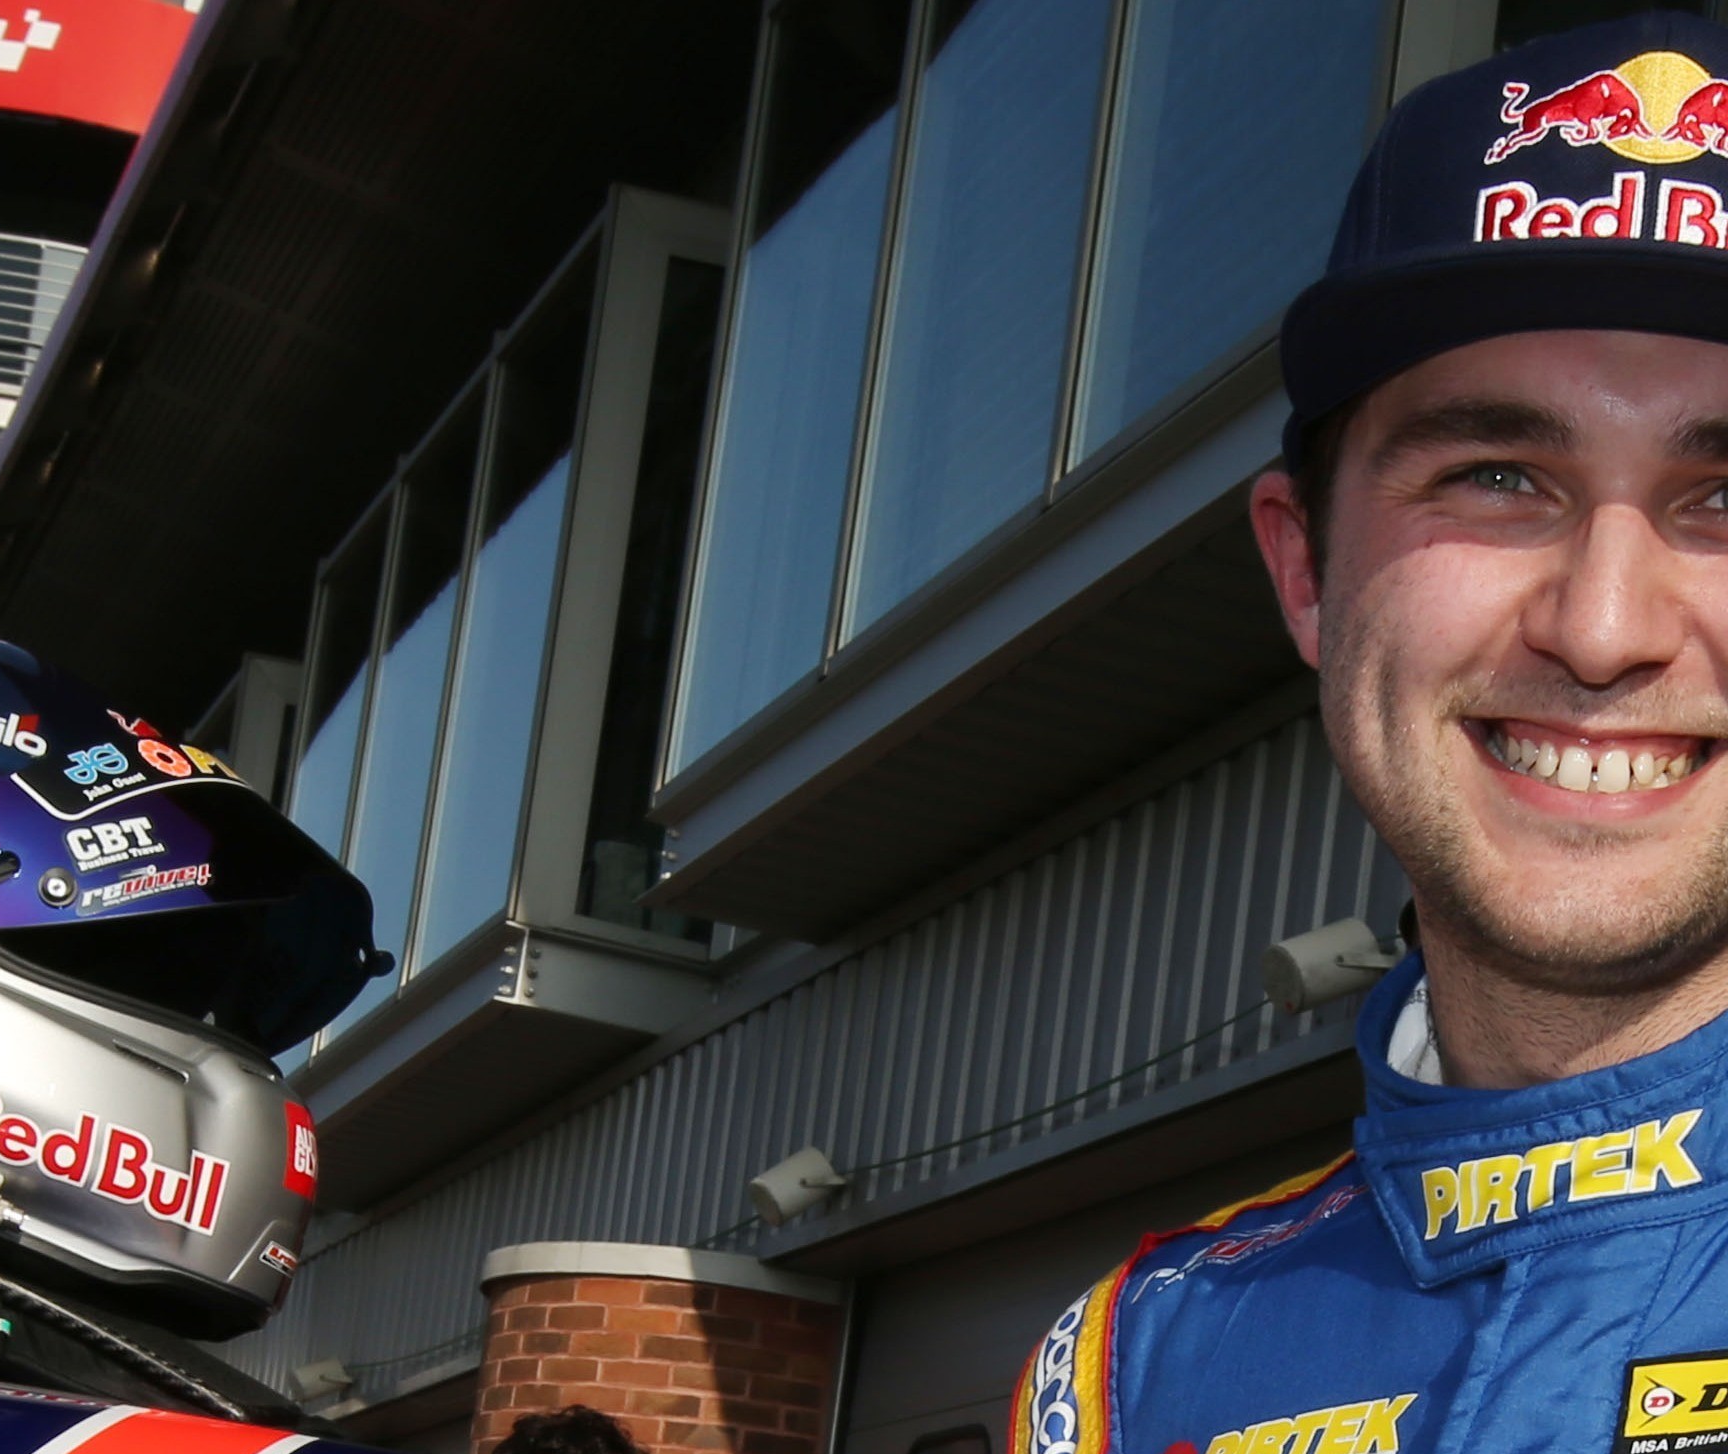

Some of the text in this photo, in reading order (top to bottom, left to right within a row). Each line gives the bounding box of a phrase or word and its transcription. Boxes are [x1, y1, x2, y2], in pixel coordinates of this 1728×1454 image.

[1474, 171, 1644, 242] Red
[67, 816, 152, 862] CBT
[93, 1125, 228, 1234] Bull
[1421, 1108, 1703, 1241] PIRTEK
[1673, 1431, 1728, 1451] British
